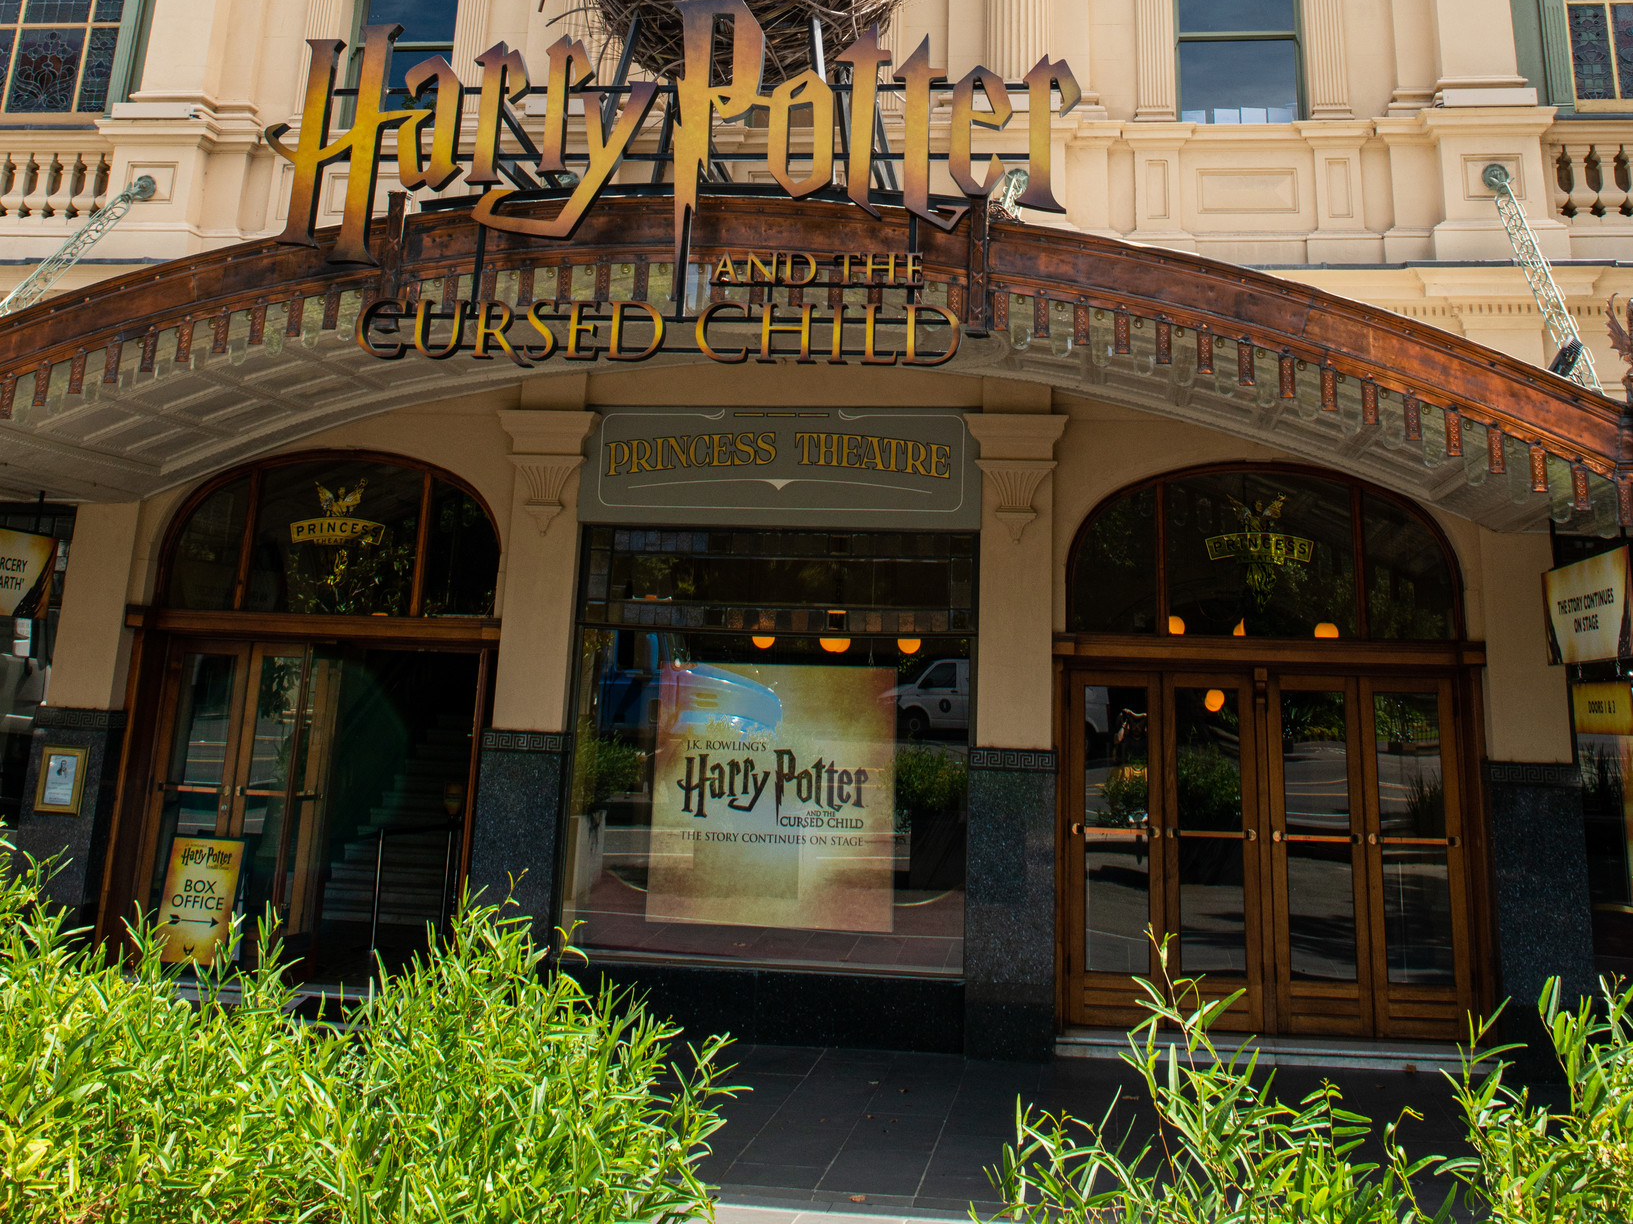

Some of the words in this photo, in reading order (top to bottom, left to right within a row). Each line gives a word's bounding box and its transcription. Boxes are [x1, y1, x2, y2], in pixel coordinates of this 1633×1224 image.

[265, 23, 658, 266] Harry
[710, 251, 818, 287] AND
[836, 251, 925, 288] THE
[356, 298, 666, 368] CURSED
[695, 300, 961, 366] CHILD
[605, 431, 777, 476] PRINCESS
[794, 431, 951, 479] THEATRE
[296, 522, 379, 538] PRINCESS
[1213, 538, 1307, 554] PRINCESS
[1557, 600, 1568, 615] THE
[1568, 596, 1583, 613] STORY
[1583, 587, 1615, 611] CONTINUES
[1574, 618, 1582, 633] ON
[1582, 614, 1599, 632] STAGE
[1588, 701, 1604, 714] DOORS
[686, 740, 702, 752] J.K.
[706, 740, 767, 752] ROWLING'S
[677, 753, 770, 818] Harry
[773, 748, 869, 825] Potter
[780, 816, 824, 828] CURSED
[827, 817, 864, 829] CHILD
[806, 810, 822, 818] AND
[823, 810, 836, 818] THE
[680, 831, 702, 841] THE
[705, 832, 738, 842] STORY
[742, 833, 807, 845] CONTINUES
[810, 835, 827, 846] ON
[831, 836, 864, 847] STAGE
[181, 848, 207, 866] Harry
[206, 847, 233, 866] Potter
[184, 879, 217, 894] BOX
[171, 894, 225, 911] OFFICE
